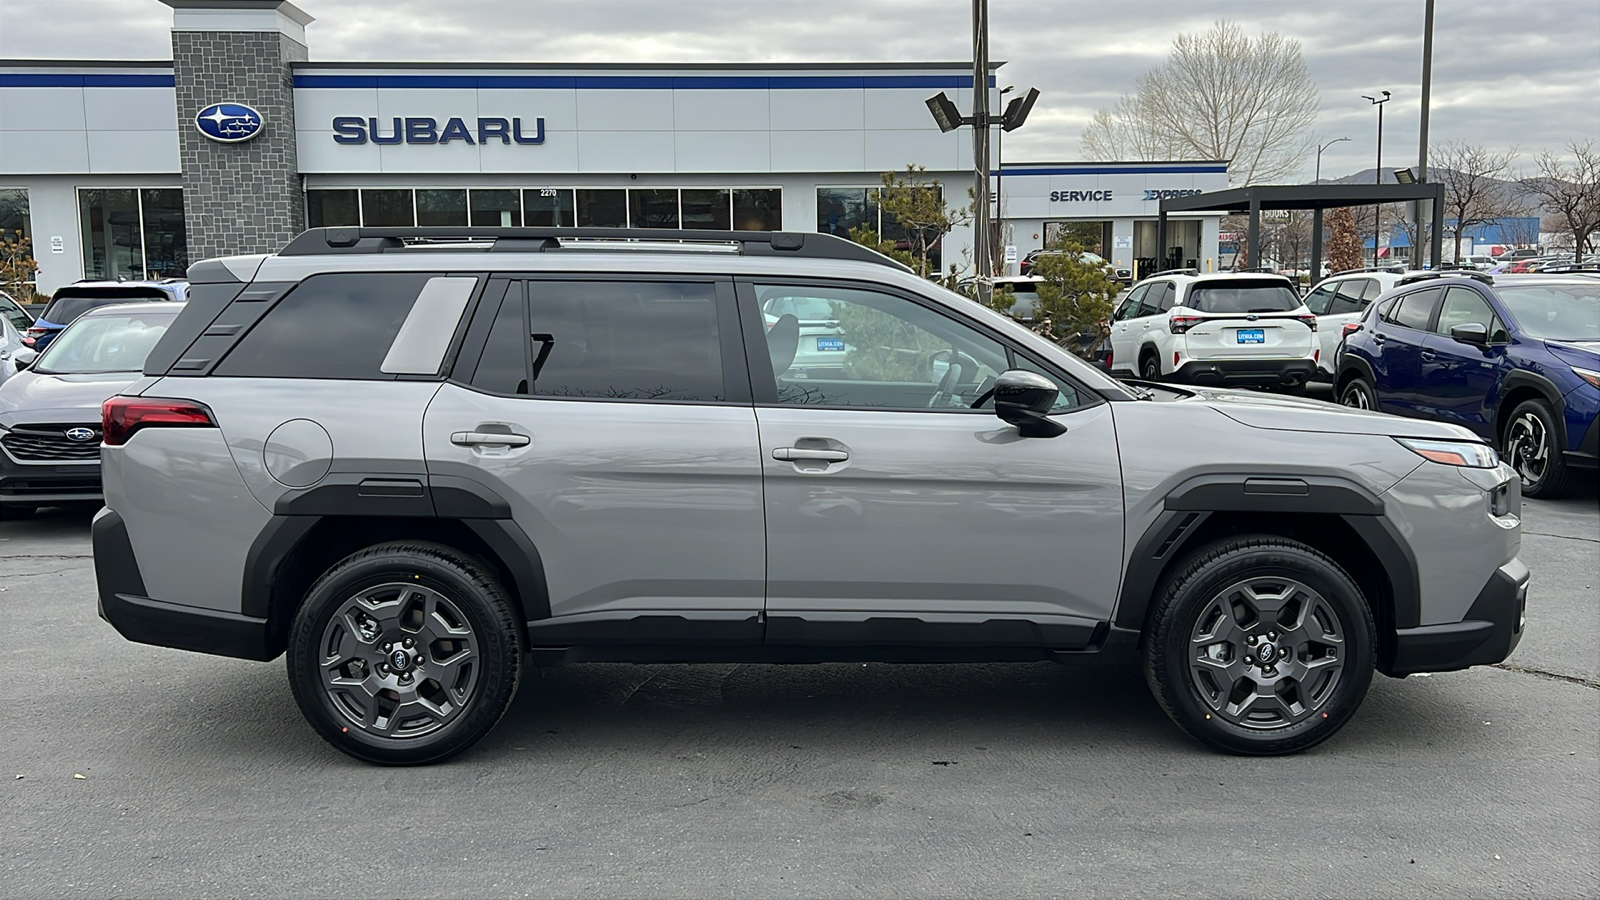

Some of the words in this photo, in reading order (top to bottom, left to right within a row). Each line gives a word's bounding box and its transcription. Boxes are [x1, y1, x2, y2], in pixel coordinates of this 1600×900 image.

[332, 116, 546, 145] SUBARU
[540, 189, 557, 197] 2270
[1050, 190, 1113, 202] SERVICE
